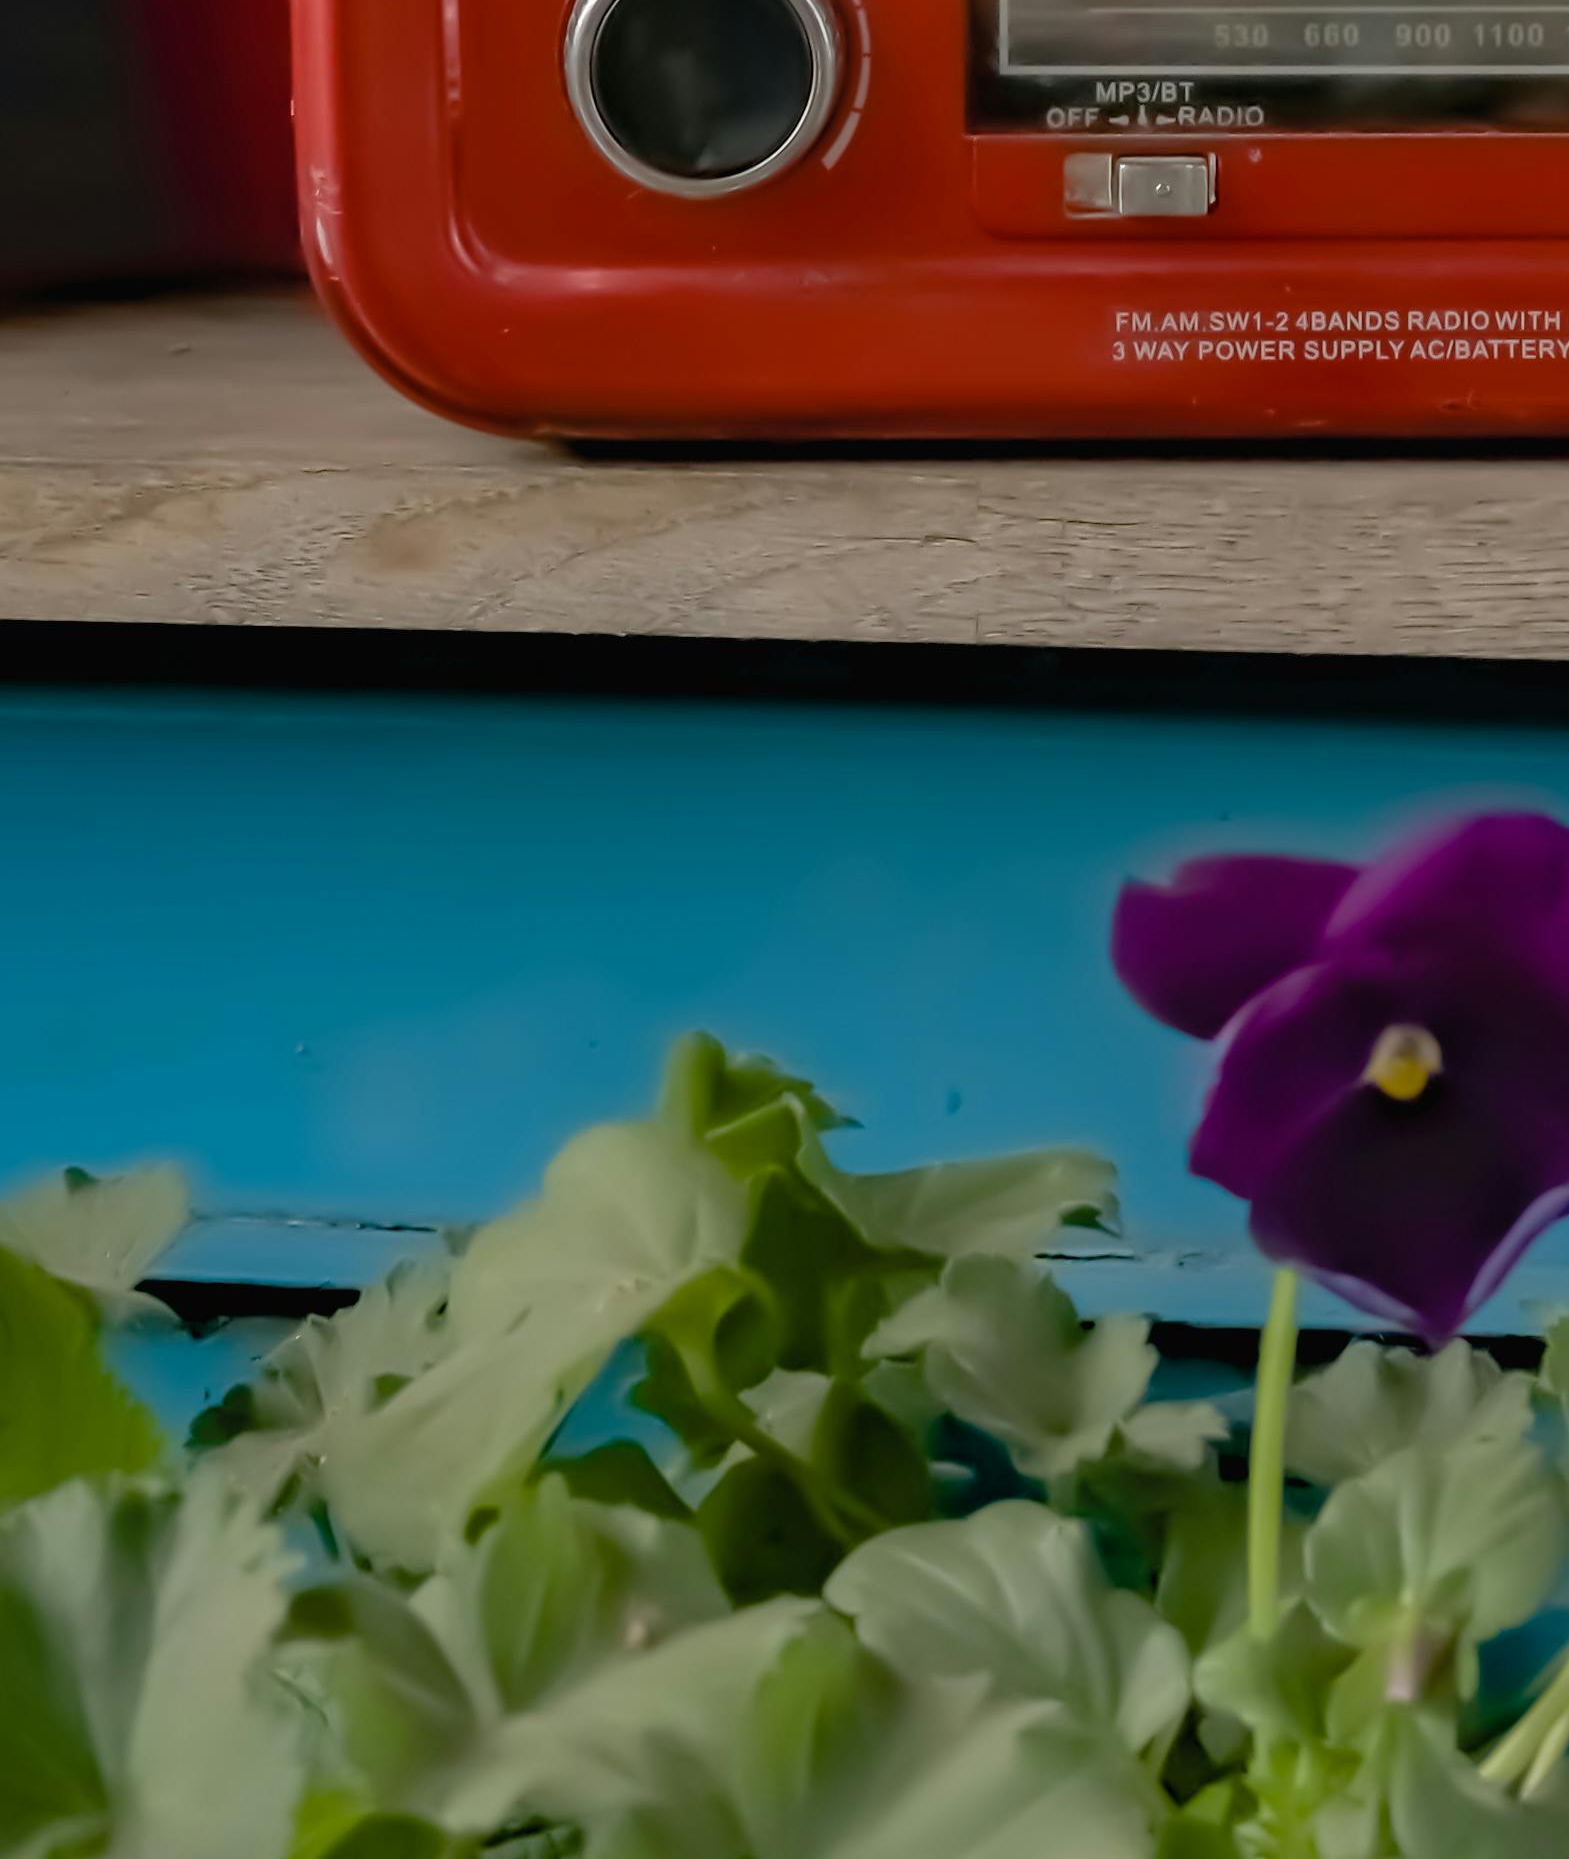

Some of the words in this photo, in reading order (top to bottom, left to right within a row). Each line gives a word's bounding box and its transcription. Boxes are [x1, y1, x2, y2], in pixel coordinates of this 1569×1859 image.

[1214, 24, 1269, 48] 530
[1304, 23, 1359, 48] 660
[1395, 23, 1451, 48] 900
[1474, 23, 1544, 48] 1100
[1096, 82, 1194, 104] MP3/BT
[1046, 108, 1098, 128] OFF
[1177, 106, 1264, 127] RADIO
[1115, 311, 1289, 332] FM.AM.SW1-2
[1296, 311, 1399, 331] 4BANDS
[1407, 311, 1489, 331] RADIO
[1496, 310, 1560, 331] WITH
[1112, 341, 1126, 361] 3
[1135, 341, 1188, 361] WAY
[1200, 340, 1295, 360] POWER
[1304, 340, 1403, 360] SUPPLY
